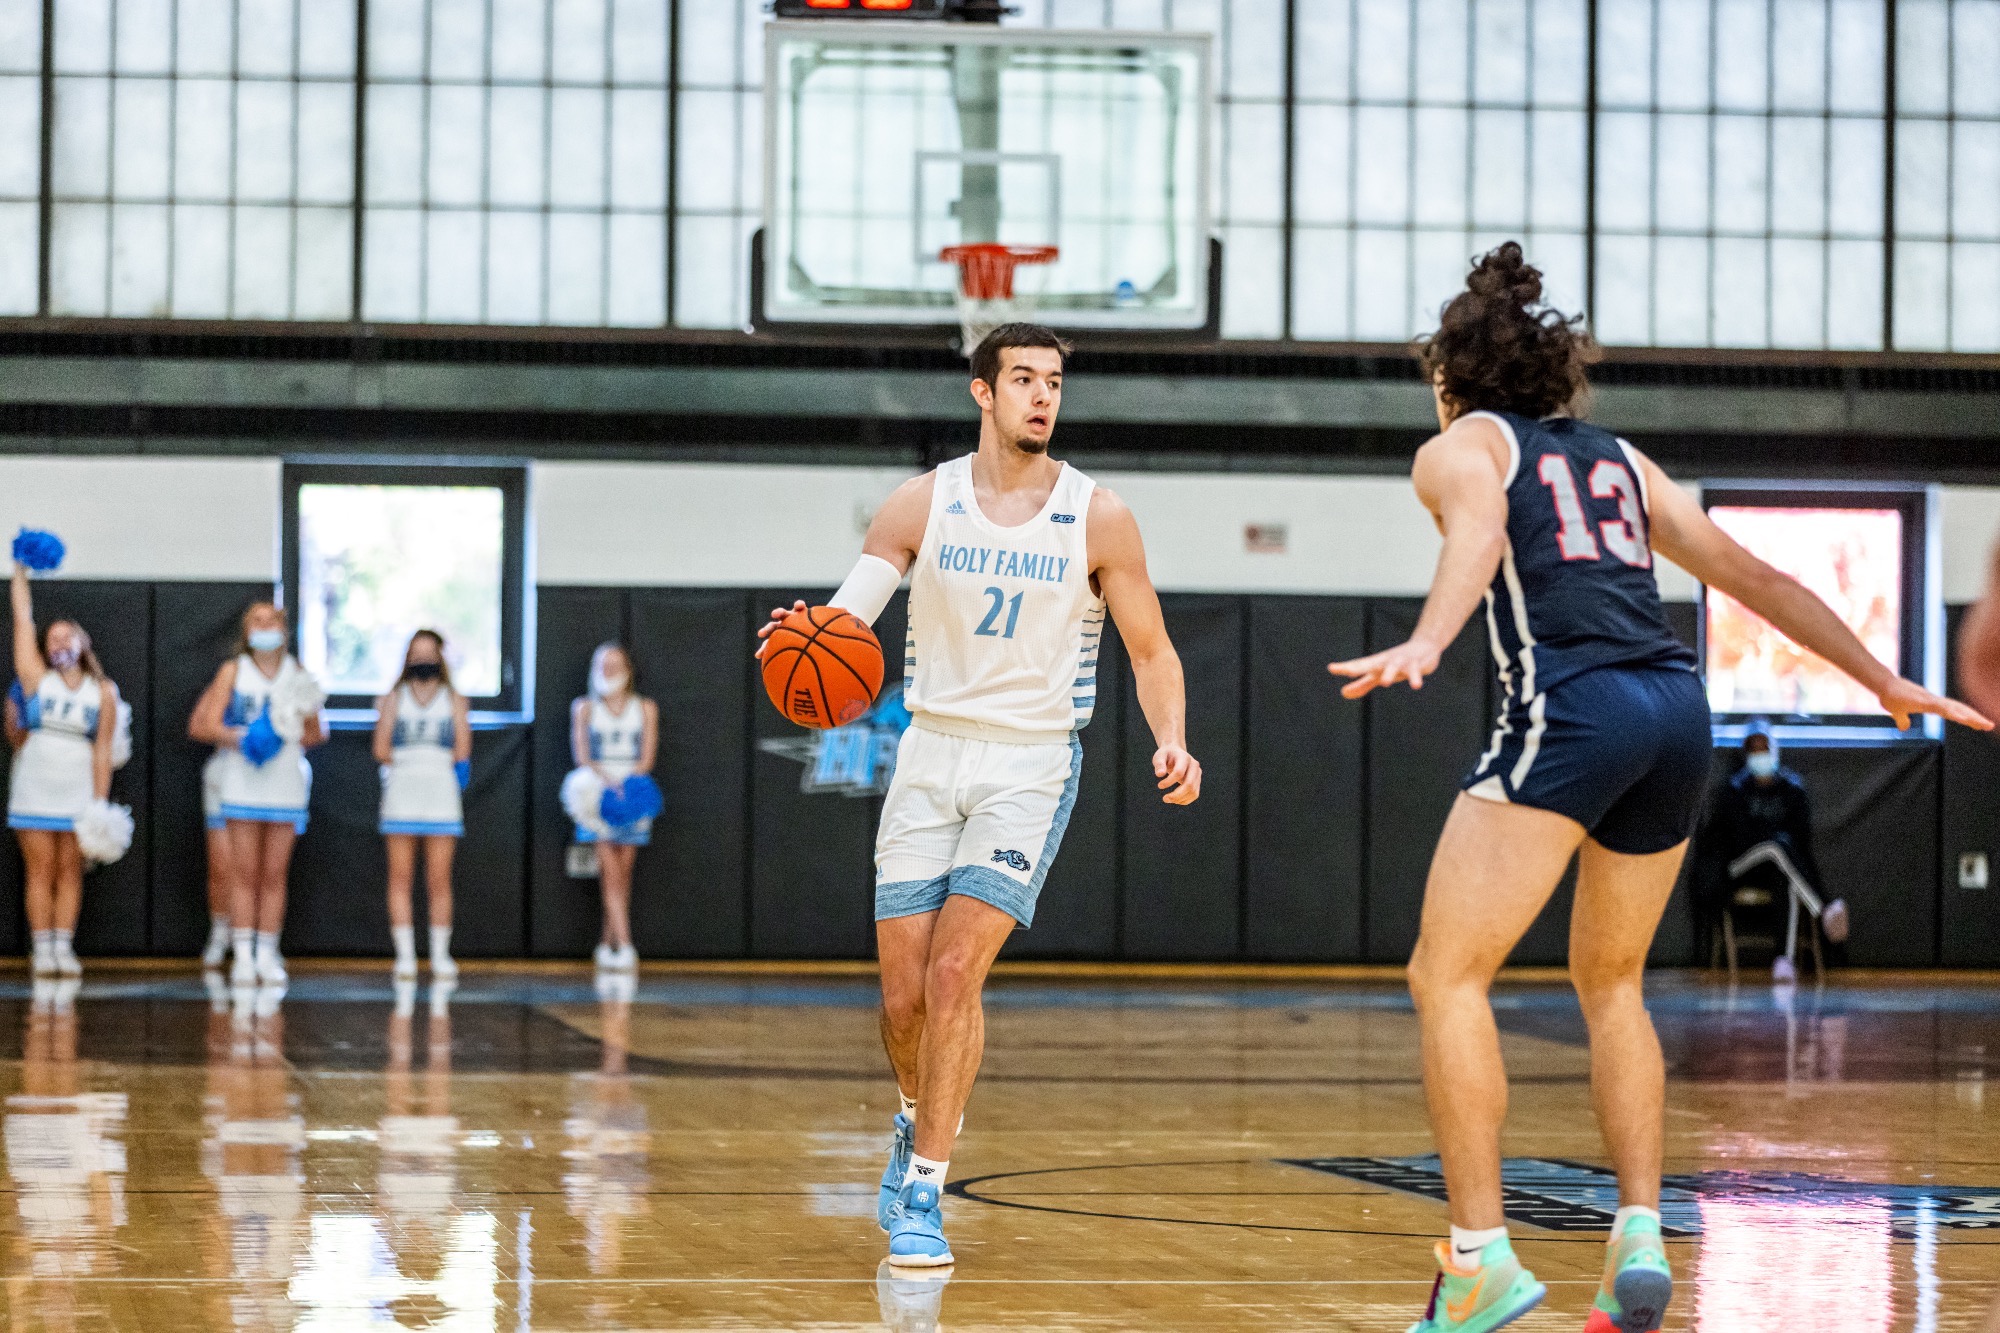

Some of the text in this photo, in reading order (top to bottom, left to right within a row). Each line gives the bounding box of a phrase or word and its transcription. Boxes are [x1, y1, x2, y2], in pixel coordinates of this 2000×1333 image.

[1050, 513, 1076, 524] CACC
[1537, 454, 1651, 569] 13
[939, 544, 1070, 583] HOLY FAMILY
[973, 586, 1025, 639] 21
[793, 687, 819, 718] THE
